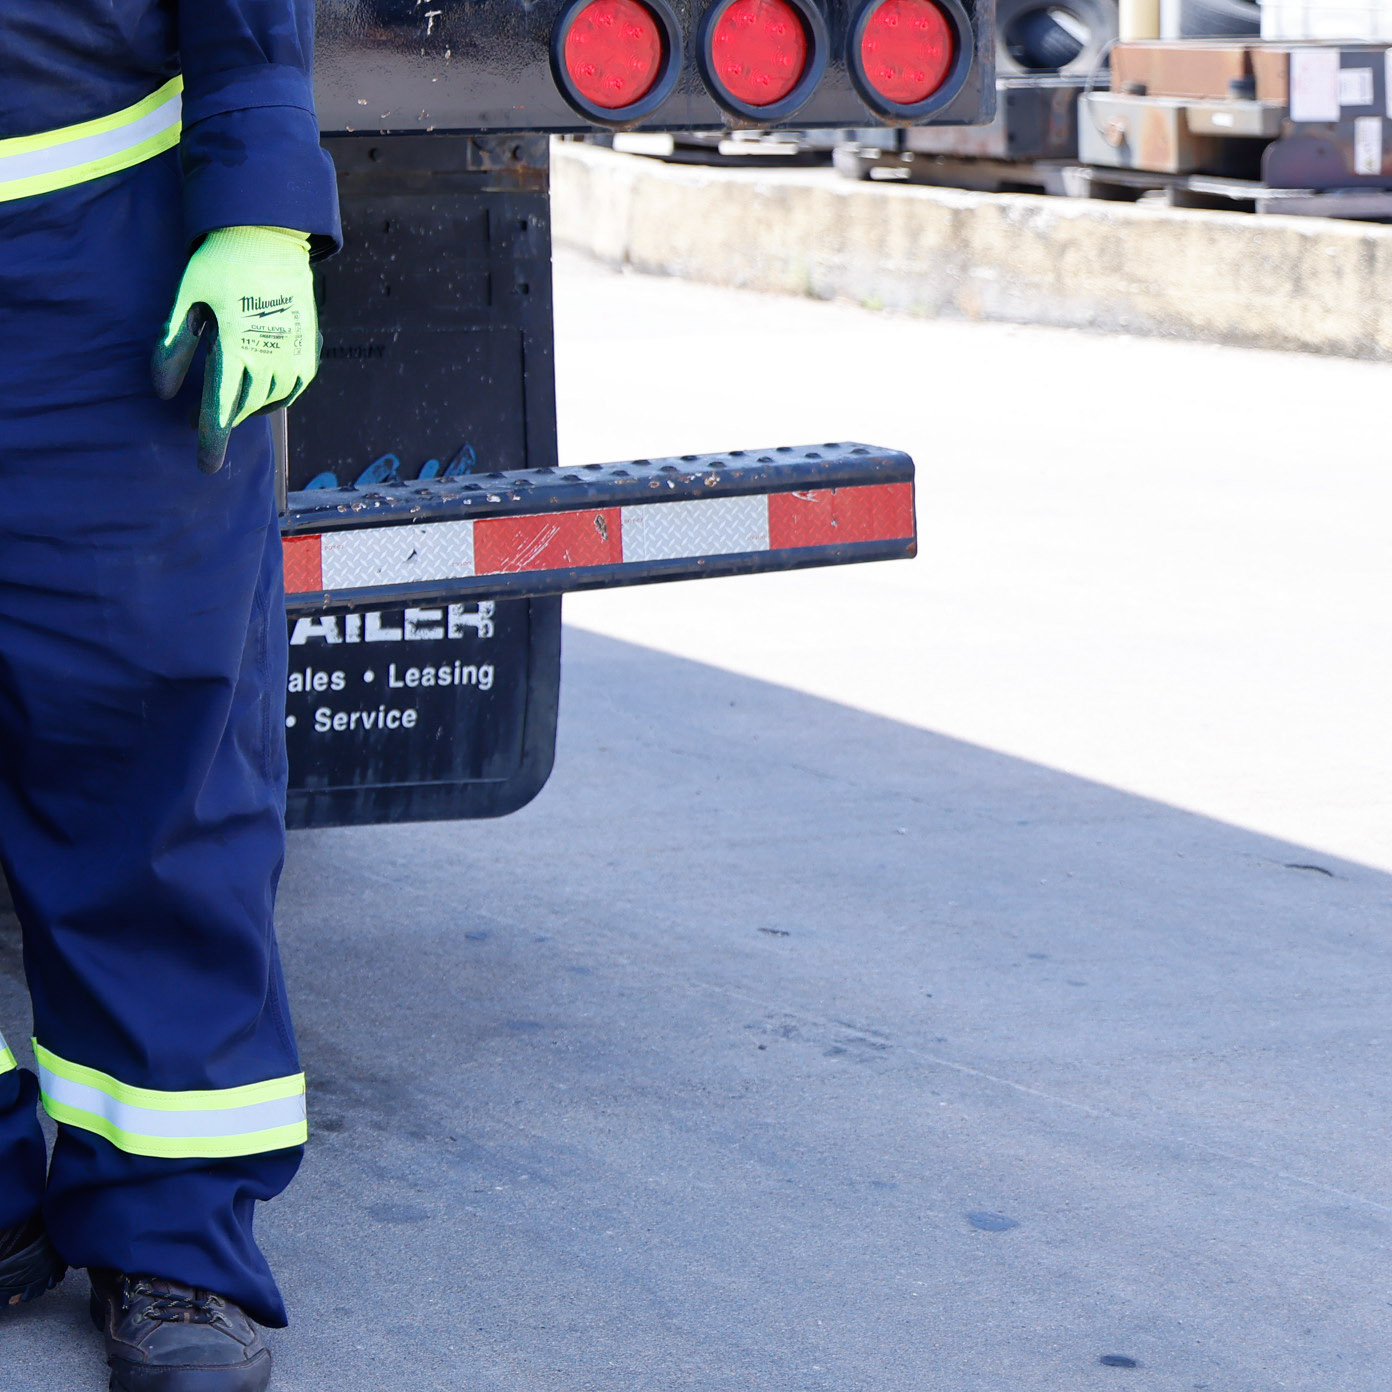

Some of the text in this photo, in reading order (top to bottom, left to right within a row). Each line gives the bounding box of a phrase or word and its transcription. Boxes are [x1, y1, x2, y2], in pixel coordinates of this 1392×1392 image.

[238, 295, 294, 312] Milwaukee
[289, 600, 495, 645] AILER
[288, 660, 494, 693] ales Leasing
[314, 705, 418, 732] Service
